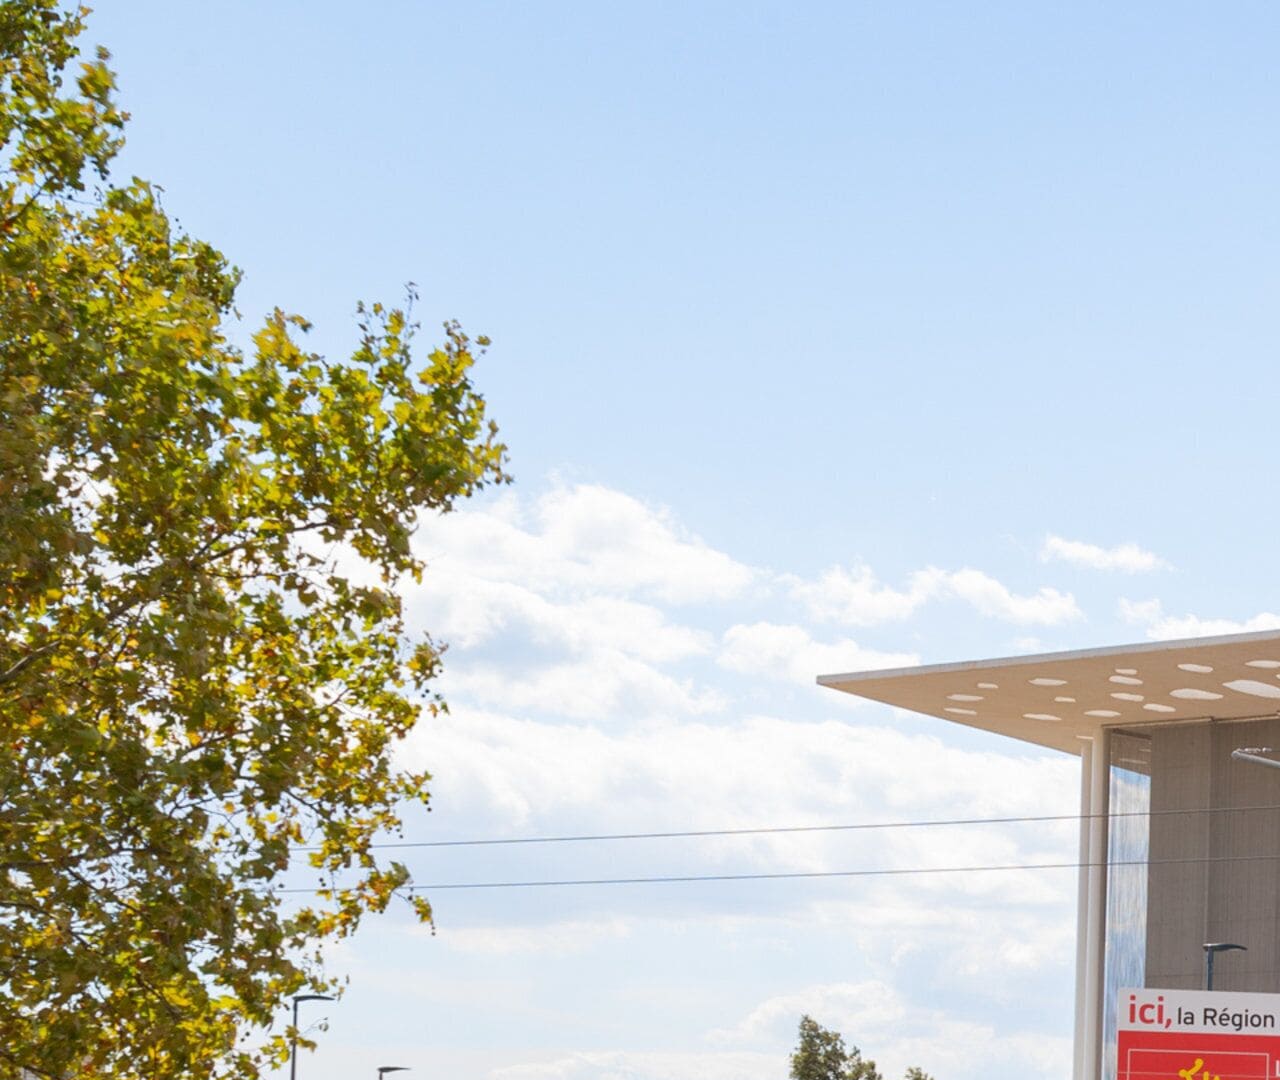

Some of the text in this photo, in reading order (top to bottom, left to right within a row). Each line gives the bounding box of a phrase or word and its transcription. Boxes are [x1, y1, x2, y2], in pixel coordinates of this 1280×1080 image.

[1129, 994, 1172, 1029] ici,
[1177, 1007, 1195, 1025] la
[1203, 1007, 1275, 1031] Région
